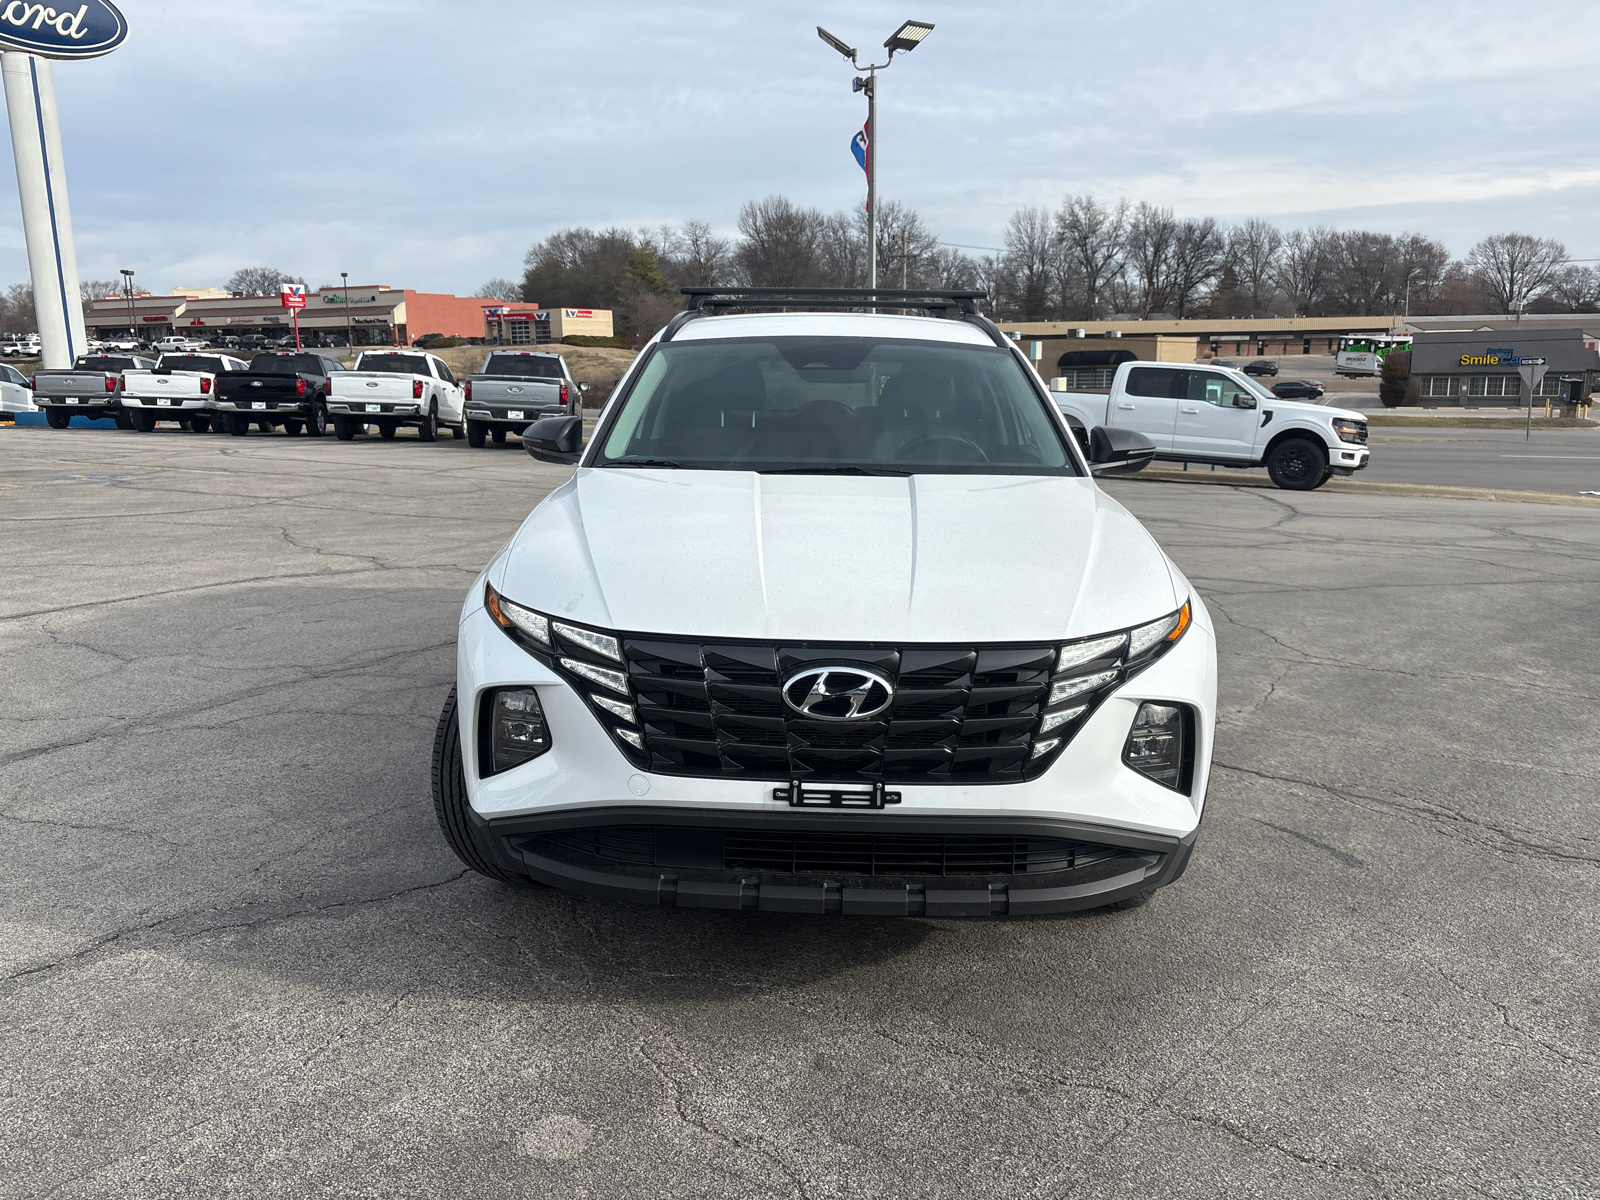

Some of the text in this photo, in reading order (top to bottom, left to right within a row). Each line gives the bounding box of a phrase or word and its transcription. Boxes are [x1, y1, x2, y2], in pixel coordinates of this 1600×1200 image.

[0, 0, 89, 39] ord
[1460, 353, 1529, 365] Smile Ca
